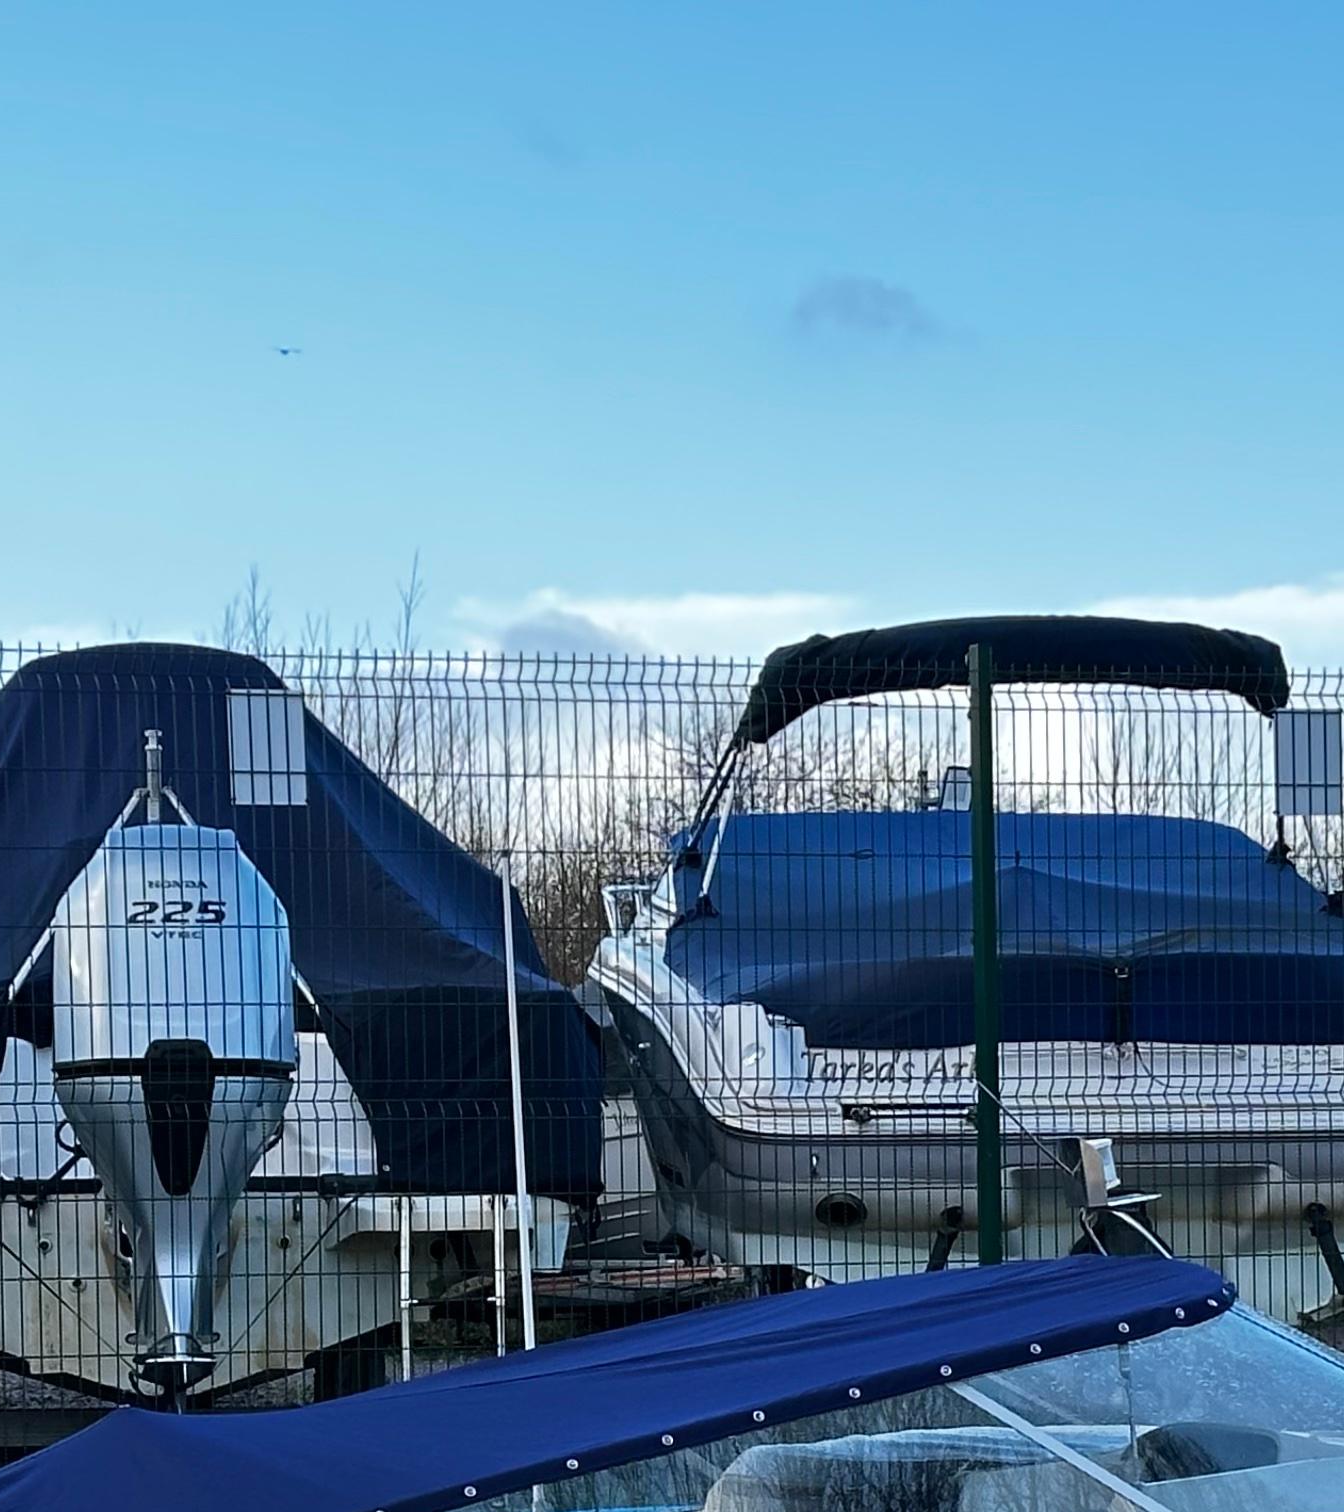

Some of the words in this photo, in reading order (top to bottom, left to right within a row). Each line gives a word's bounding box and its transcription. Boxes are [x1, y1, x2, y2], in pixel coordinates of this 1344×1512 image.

[147, 880, 208, 889] HONDA
[127, 901, 227, 924] 225
[151, 930, 203, 940] VTEC
